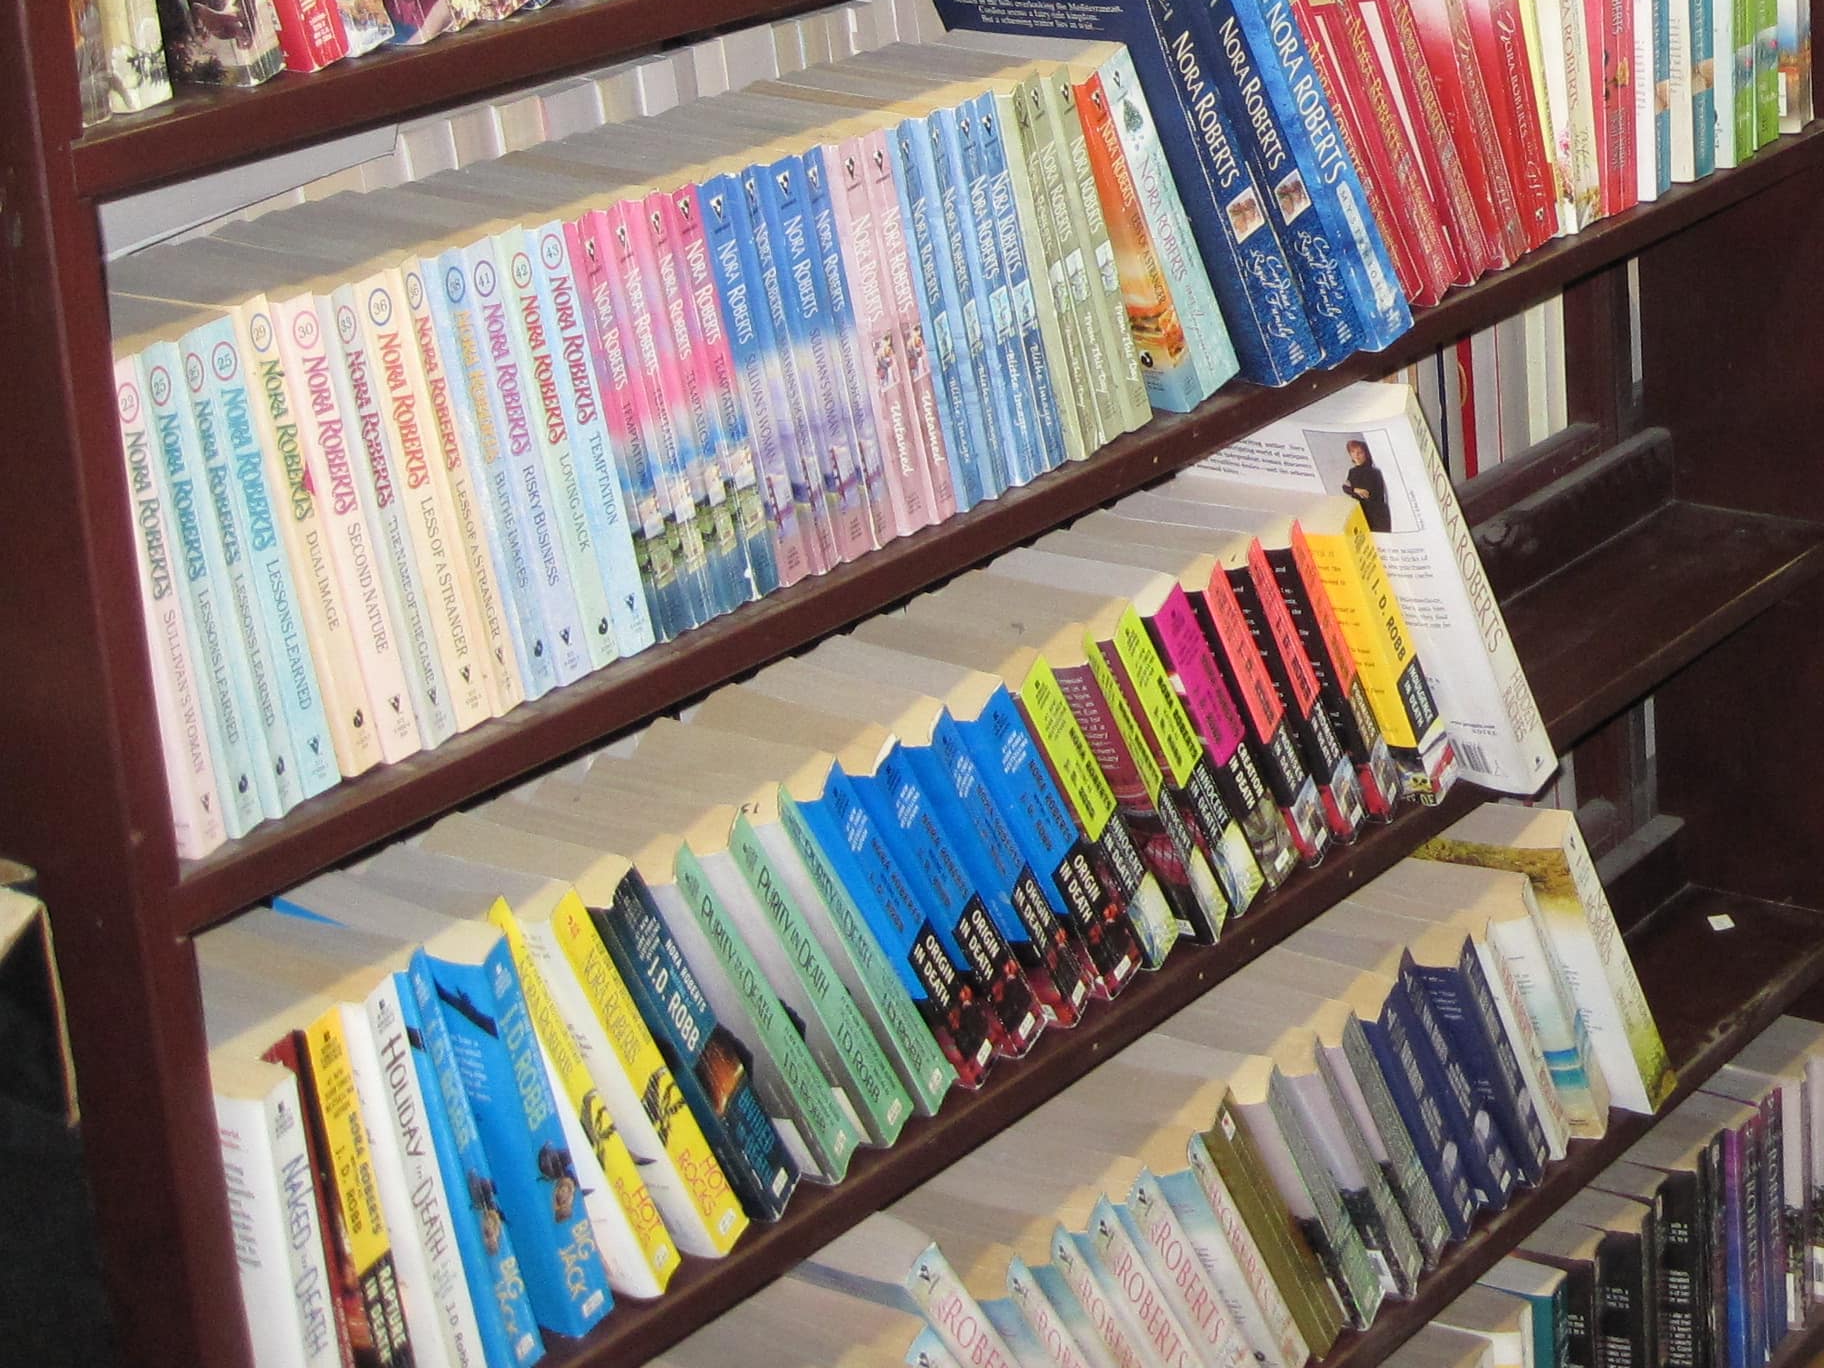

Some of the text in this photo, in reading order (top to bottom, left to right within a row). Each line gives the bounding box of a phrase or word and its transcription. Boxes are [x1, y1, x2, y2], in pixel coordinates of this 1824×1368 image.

[1171, 31, 1242, 189] NORA ROBERTS
[1219, 17, 1286, 172] NORA ROBERTS
[1265, 2, 1348, 185] NORA ROBERTS
[1563, 22, 1578, 108] ROBERTS
[478, 270, 493, 287] 41
[515, 262, 529, 279] 42
[546, 243, 561, 259] 43
[297, 321, 315, 338] 30
[373, 298, 389, 316] 36
[121, 394, 135, 412] 22
[217, 352, 233, 371] 25
[549, 274, 619, 528] NORA ROBERTS TEMPTATION
[484, 302, 561, 588] NORA ROBERTS RISKY BUSINESS
[889, 399, 915, 478] Untamed
[920, 387, 944, 467] Untamed
[260, 359, 340, 633] NORA ROBERTS DUAL IMAGE
[301, 355, 389, 655] NORA ROBERTS SECOND NATURE
[559, 450, 592, 553] LOVING JACK
[221, 386, 313, 712] NORA ROBERTS LESSONS LEARNED
[1425, 449, 1504, 654] NORA ROBERTS
[757, 867, 830, 1000] PURITY DEATH
[1058, 854, 1102, 925] ORIGIN IN DEATH
[647, 958, 701, 1052] J.D. ROBB
[922, 959, 950, 1007] DEATH
[924, 934, 957, 987] ORIGIN
[381, 1032, 448, 1262] HOLIDAY DEATH
[675, 1148, 730, 1217] HOT ROCKS
[280, 1154, 327, 1359] NAKED DEATH
[1155, 1221, 1227, 1346] ROBERTS
